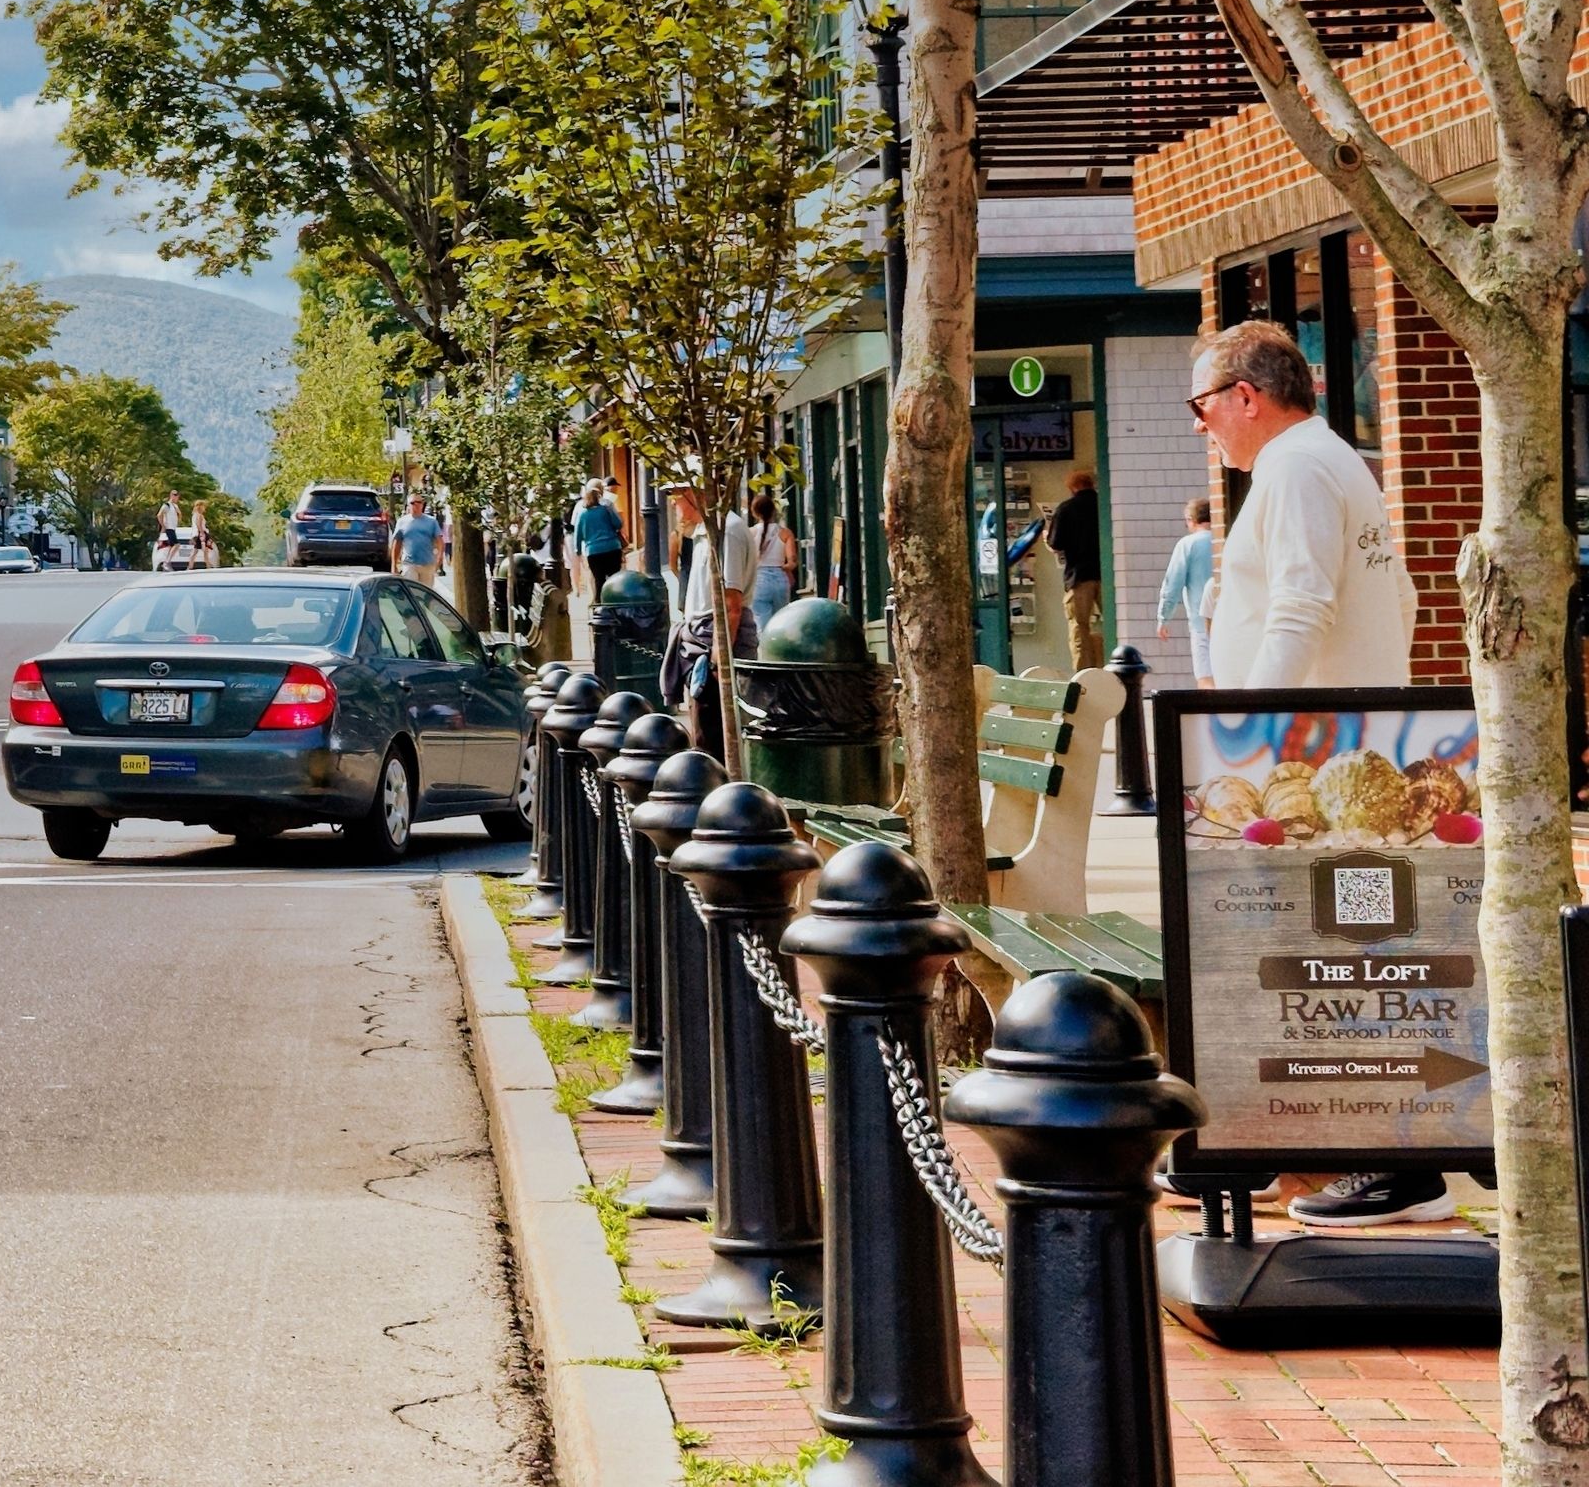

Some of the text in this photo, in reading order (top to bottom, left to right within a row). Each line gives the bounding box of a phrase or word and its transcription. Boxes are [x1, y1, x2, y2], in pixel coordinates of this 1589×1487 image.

[141, 698, 187, 714] 8225 LA
[1447, 876, 1484, 889] BOUT
[1227, 884, 1276, 897] CRAFT
[1453, 891, 1483, 904] OYS
[1214, 899, 1295, 912] COCKTAILS
[1283, 1025, 1299, 1040] &
